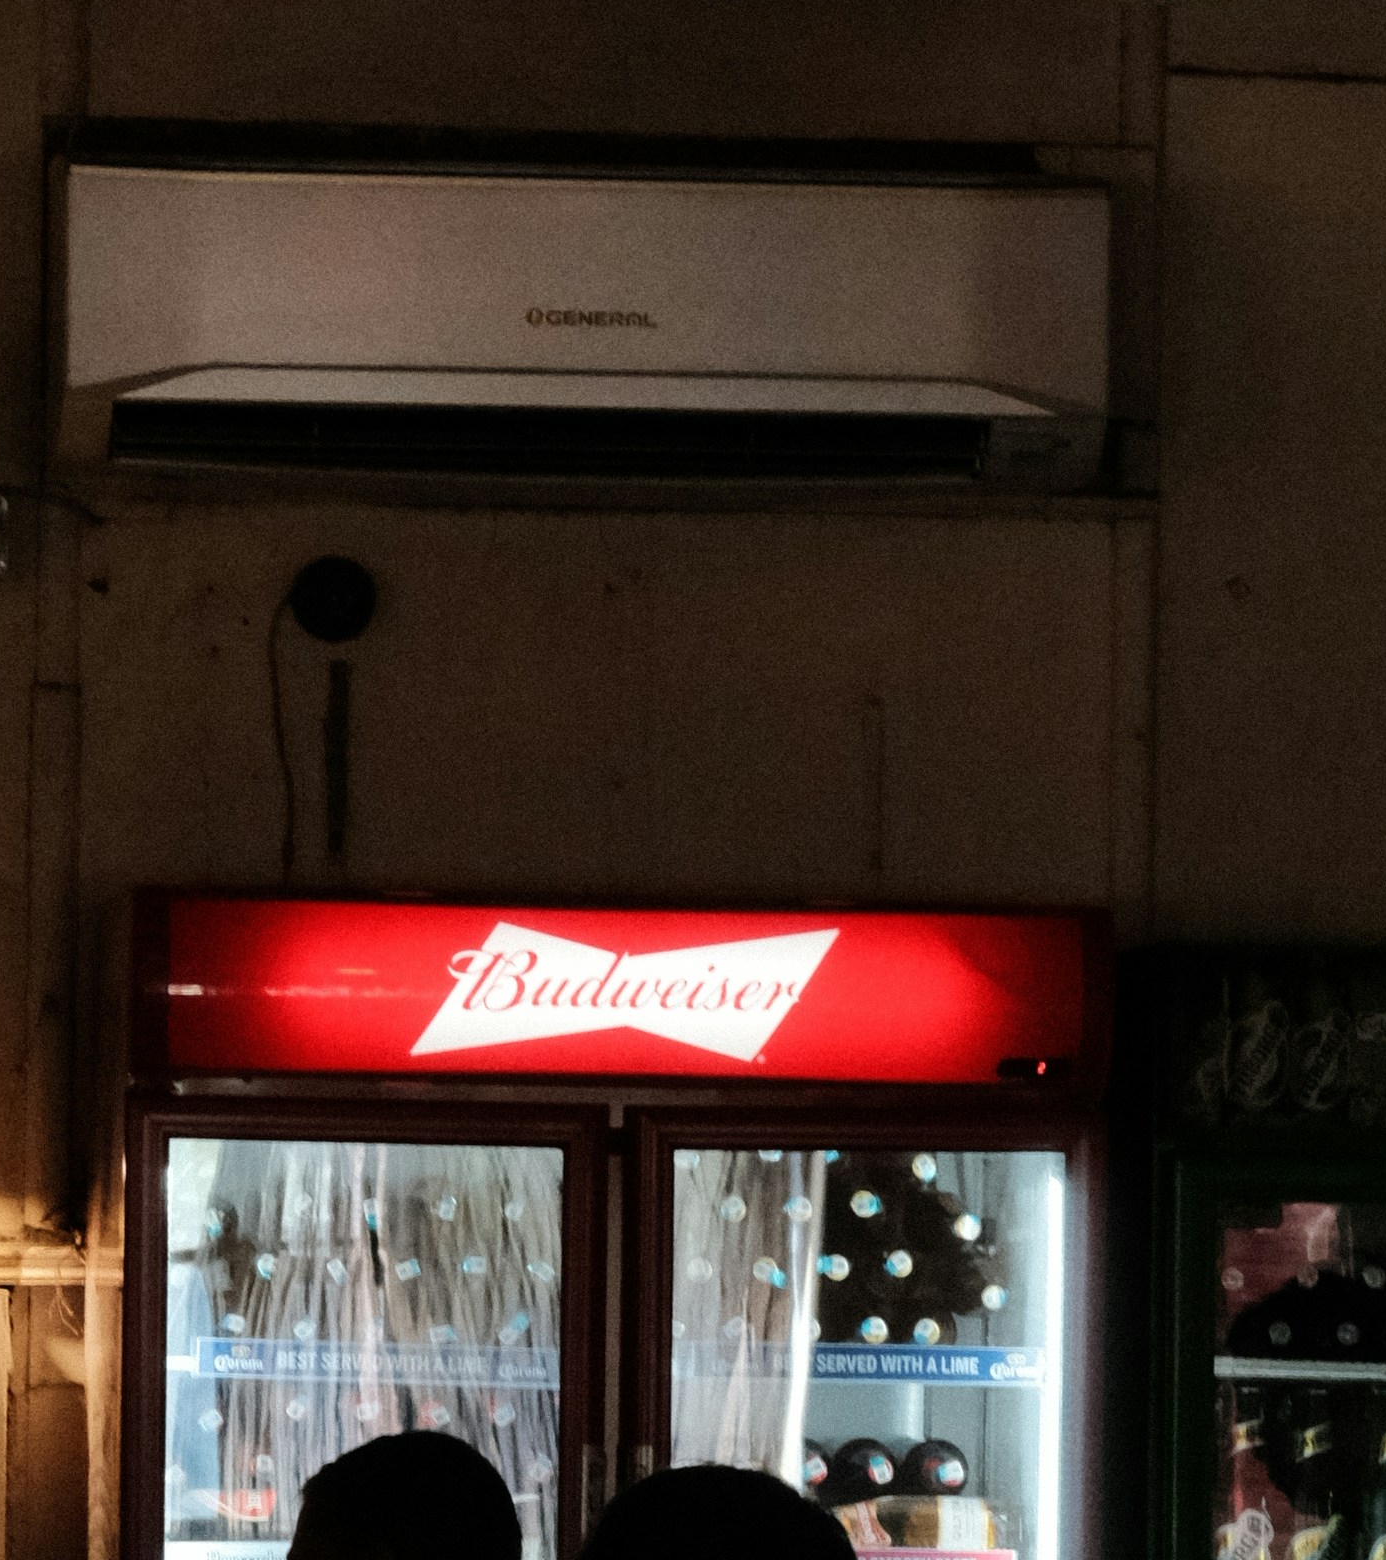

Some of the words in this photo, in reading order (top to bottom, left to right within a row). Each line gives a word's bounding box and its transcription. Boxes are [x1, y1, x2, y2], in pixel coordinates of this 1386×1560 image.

[447, 948, 800, 1014] Budweiser
[277, 1351, 316, 1370] BEST
[816, 1353, 877, 1374] SERVED
[880, 1354, 925, 1374] WITH
[926, 1356, 939, 1375] A
[941, 1356, 979, 1376] LIME
